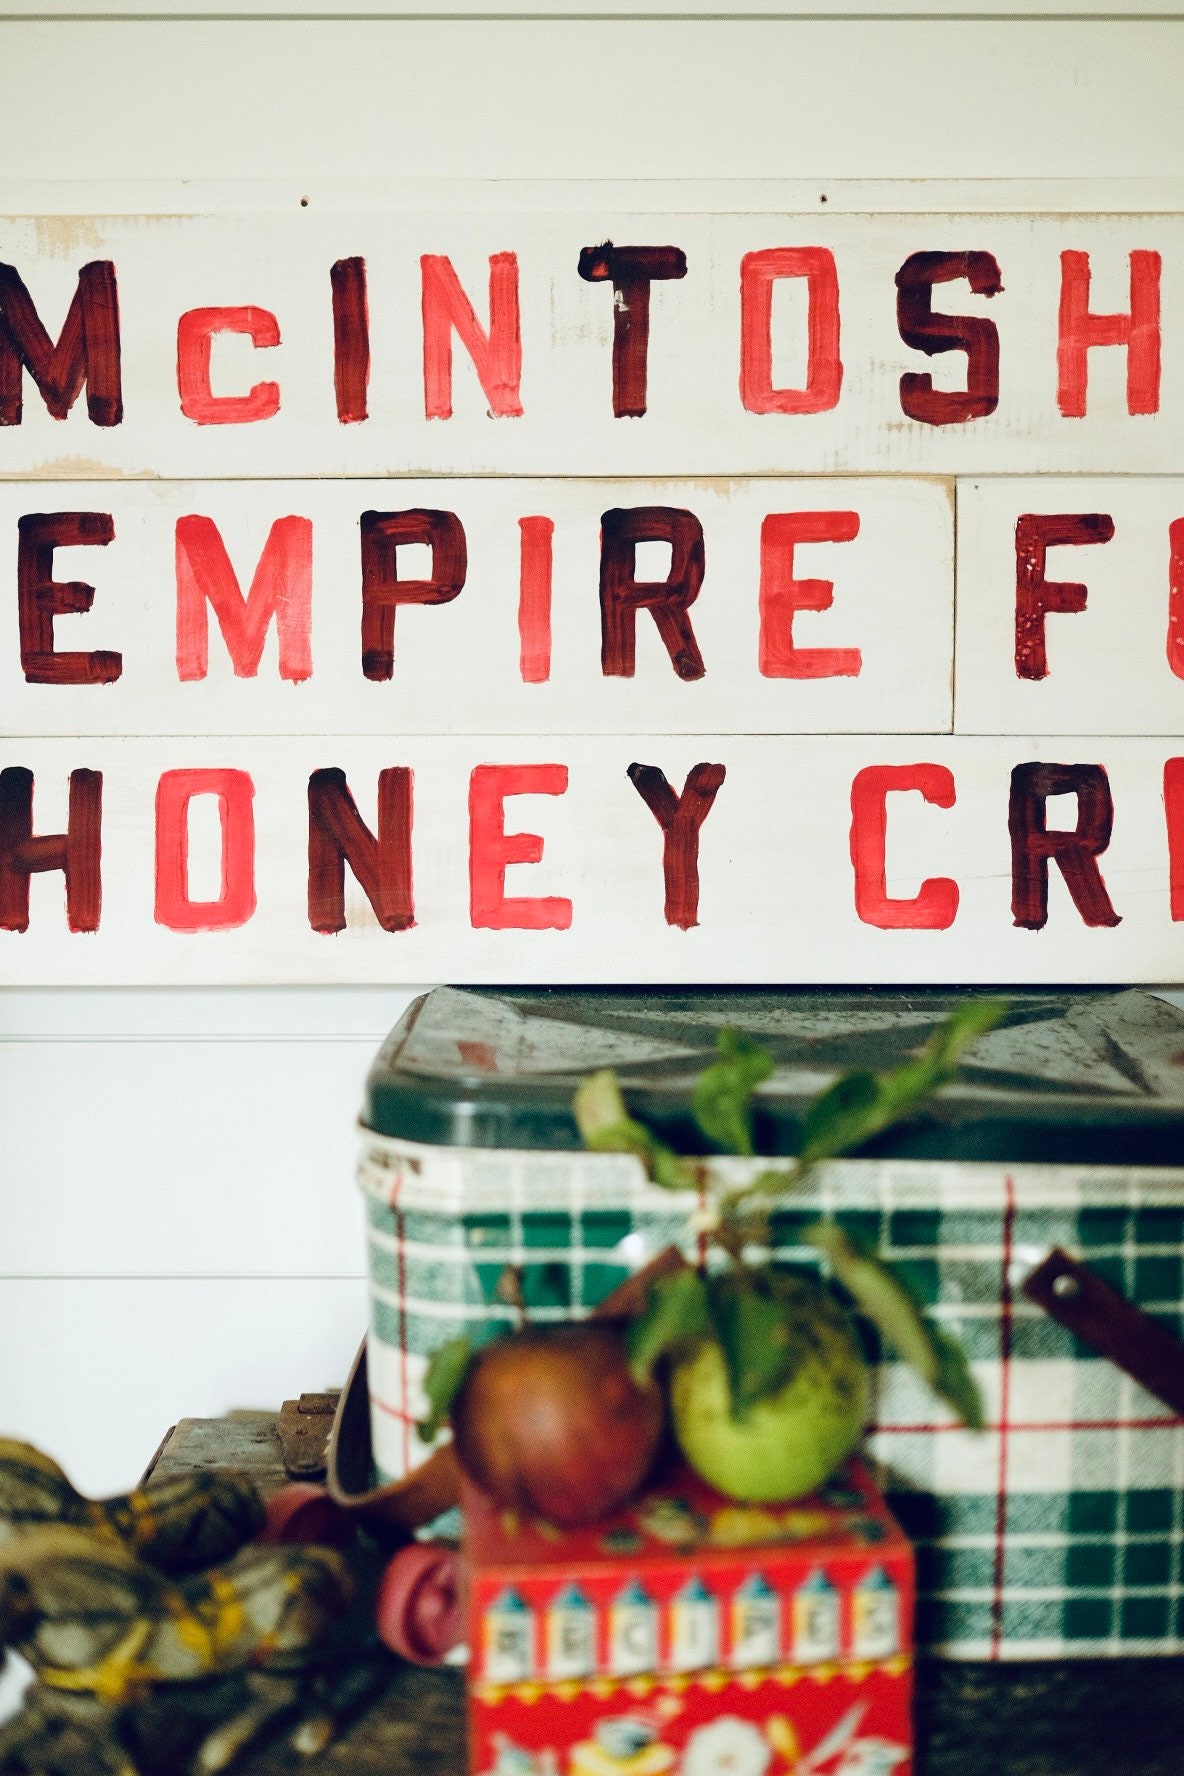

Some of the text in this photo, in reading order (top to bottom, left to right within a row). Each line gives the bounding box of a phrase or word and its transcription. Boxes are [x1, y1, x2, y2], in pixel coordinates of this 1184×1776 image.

[0, 239, 1162, 426] McINTOSH
[18, 507, 861, 684] EMPIRE
[1014, 513, 1184, 681] F
[0, 757, 1184, 933] HONEY CR
[495, 1599, 893, 1661] RECIPES
